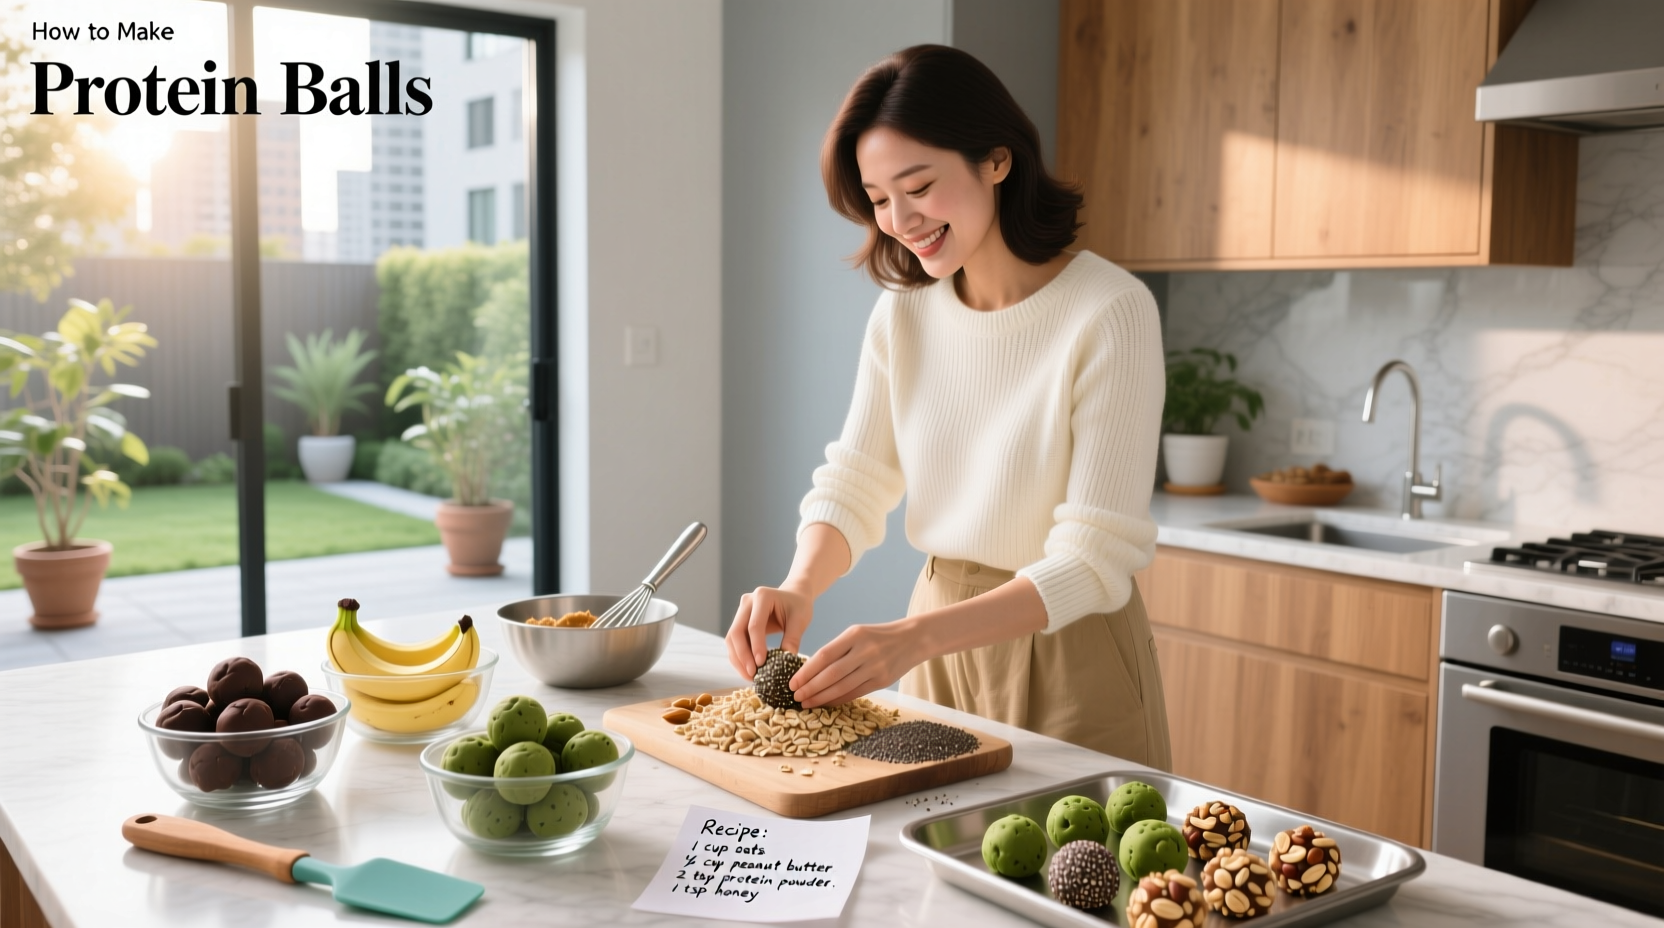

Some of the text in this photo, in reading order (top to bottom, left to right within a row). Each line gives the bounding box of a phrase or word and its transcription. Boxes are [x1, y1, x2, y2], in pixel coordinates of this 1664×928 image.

[700, 818, 768, 843] Recipe:
[691, 840, 766, 857] 1 cup oats
[729, 859, 782, 873] peanut
[786, 858, 833, 873] butter
[676, 869, 686, 880] 2
[720, 874, 773, 886] protein
[671, 880, 760, 904] 1 tsp honey
